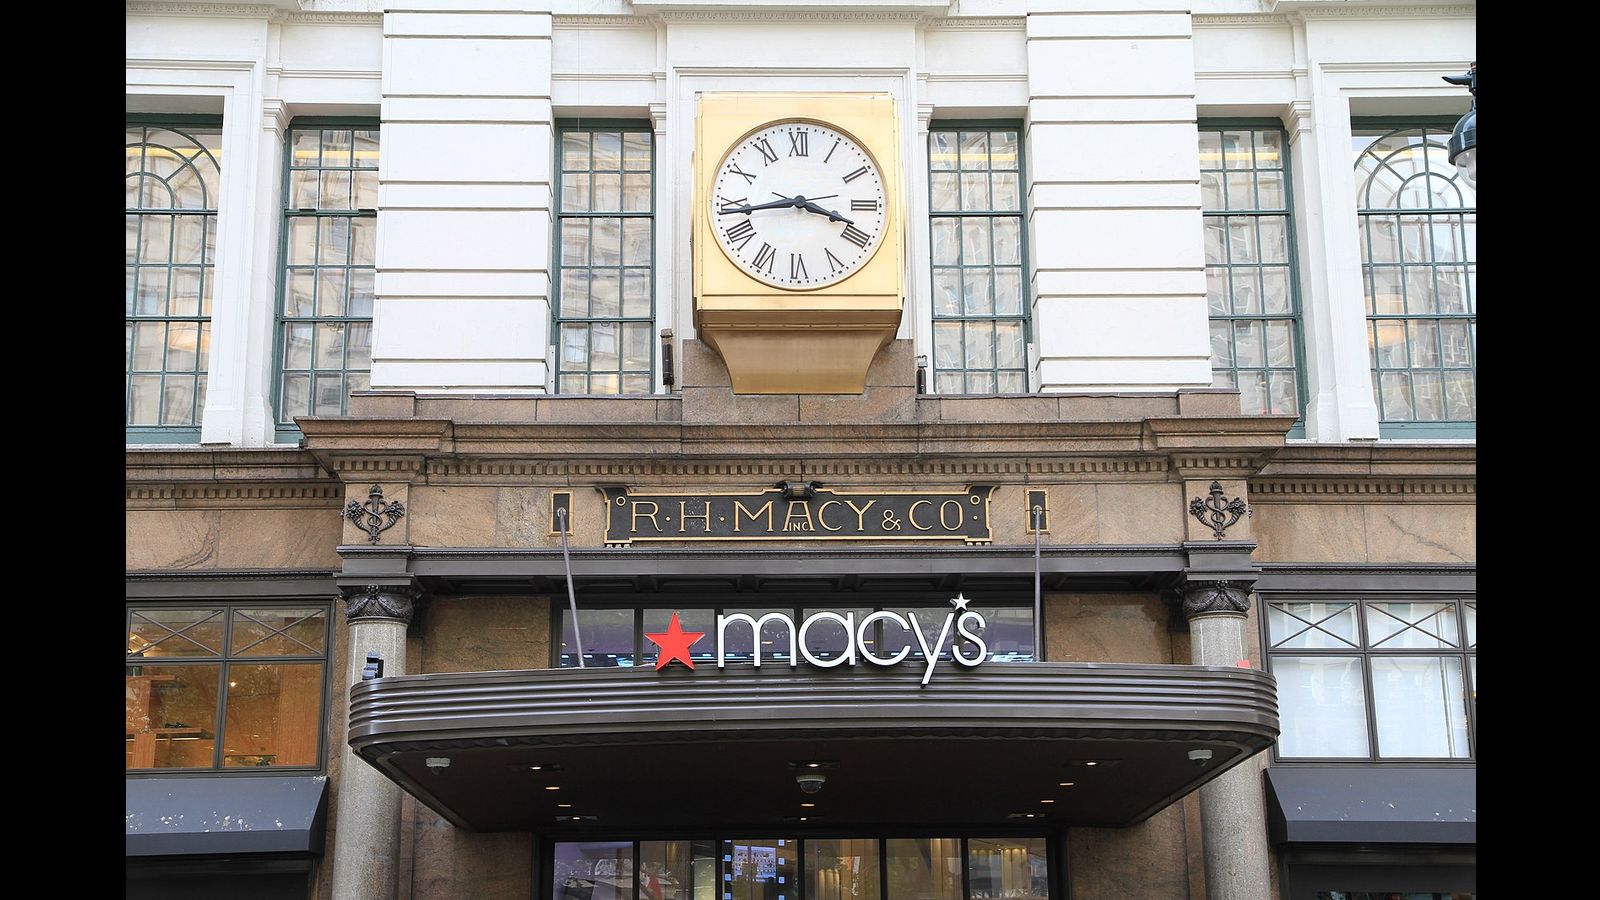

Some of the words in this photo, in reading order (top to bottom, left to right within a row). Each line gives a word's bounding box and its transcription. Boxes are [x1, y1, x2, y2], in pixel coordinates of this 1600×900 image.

[753, 138, 779, 166] XI
[789, 132, 809, 157] XII
[824, 141, 839, 163] I
[729, 163, 757, 185] X
[842, 166, 868, 184] II
[851, 200, 877, 211] III
[726, 219, 757, 251] VIII
[752, 242, 776, 274] VII
[790, 253, 809, 279] VI
[824, 248, 845, 272] V
[788, 521, 809, 532] INC
[881, 509, 901, 531] &
